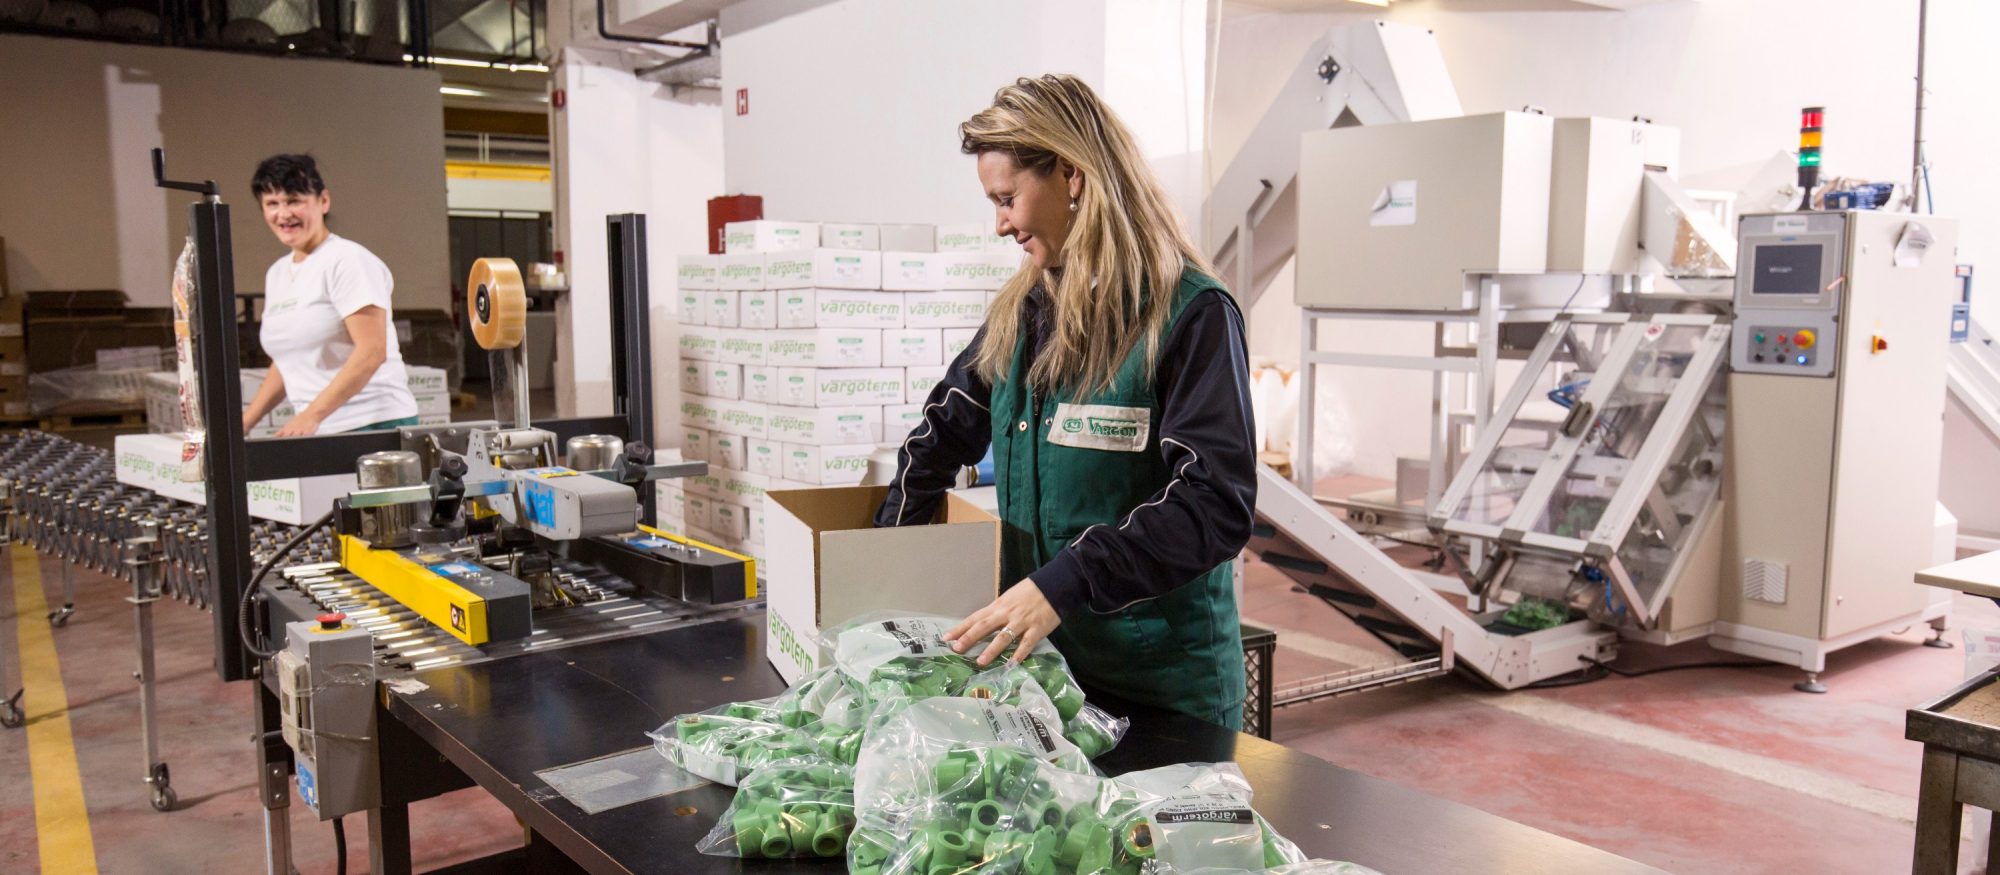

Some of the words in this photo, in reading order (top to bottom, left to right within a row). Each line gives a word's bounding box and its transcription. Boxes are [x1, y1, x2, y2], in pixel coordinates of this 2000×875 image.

[946, 264, 1016, 279] vargoterm
[820, 301, 900, 317] vargoterm
[909, 301, 983, 318] vargoterm
[769, 340, 816, 356] vargoterm
[821, 380, 900, 395] vargoterm
[769, 416, 815, 432] vargoterm
[824, 458, 869, 472] vargo
[768, 609, 814, 674] vargoterm
[1171, 809, 1239, 822] vargoterm
